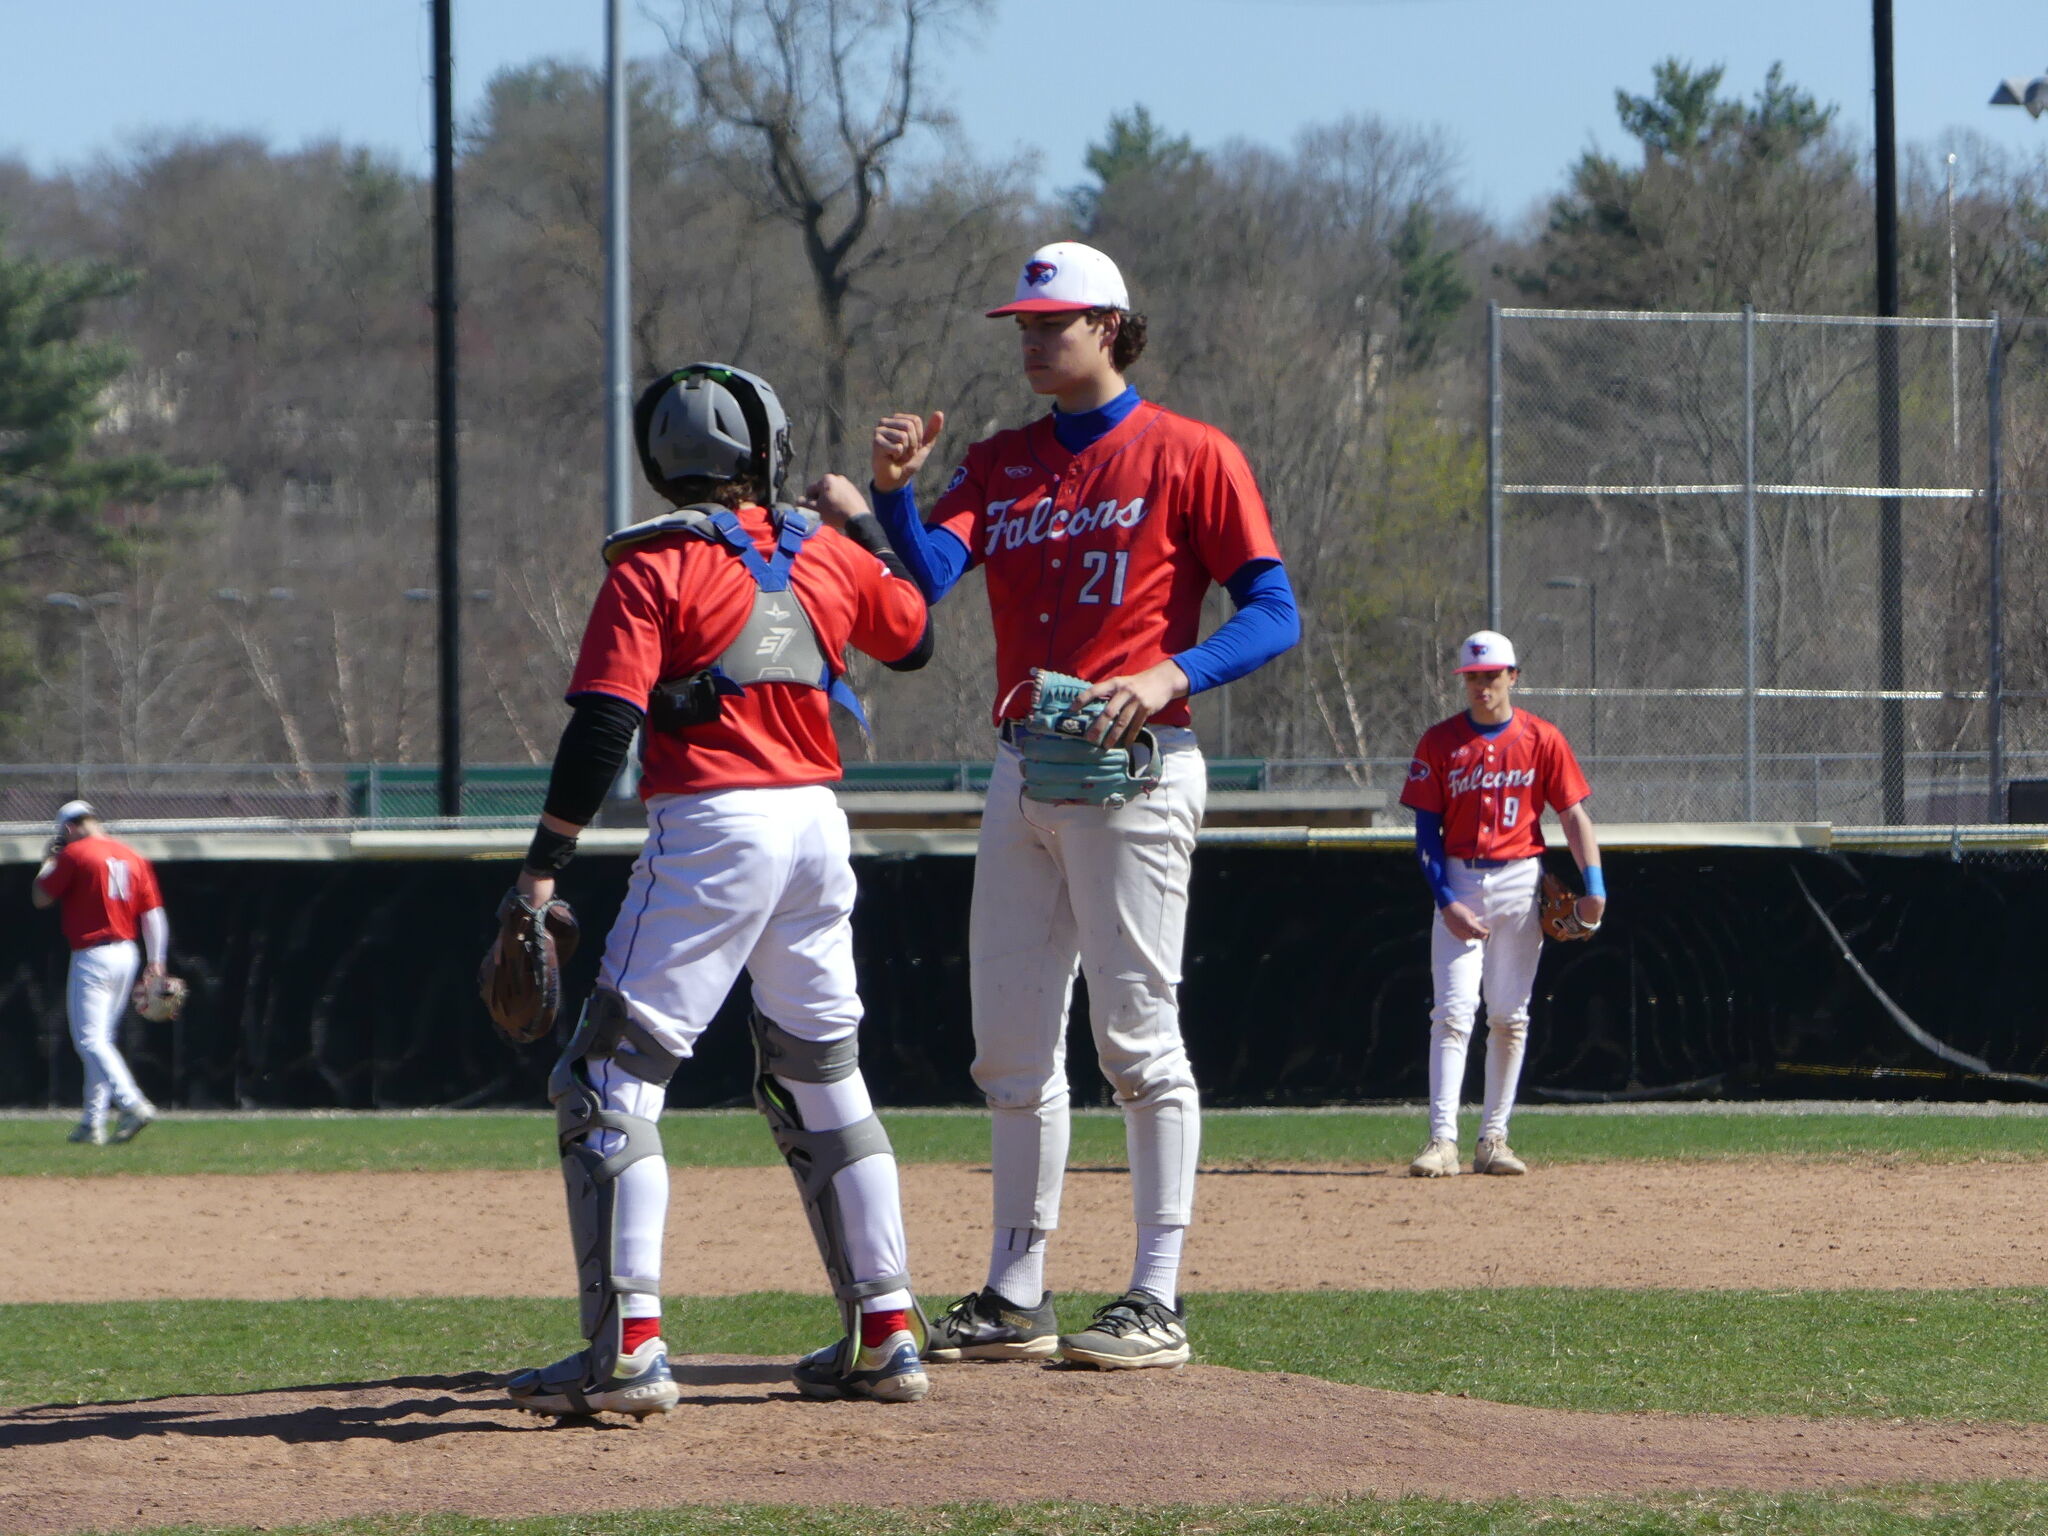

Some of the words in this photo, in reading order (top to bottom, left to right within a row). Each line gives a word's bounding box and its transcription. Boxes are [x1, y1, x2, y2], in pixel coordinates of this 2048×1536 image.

[985, 497, 1147, 556] Falcons
[1078, 550, 1129, 605] 21
[1448, 764, 1535, 798] Falcons
[1502, 797, 1519, 827] 9
